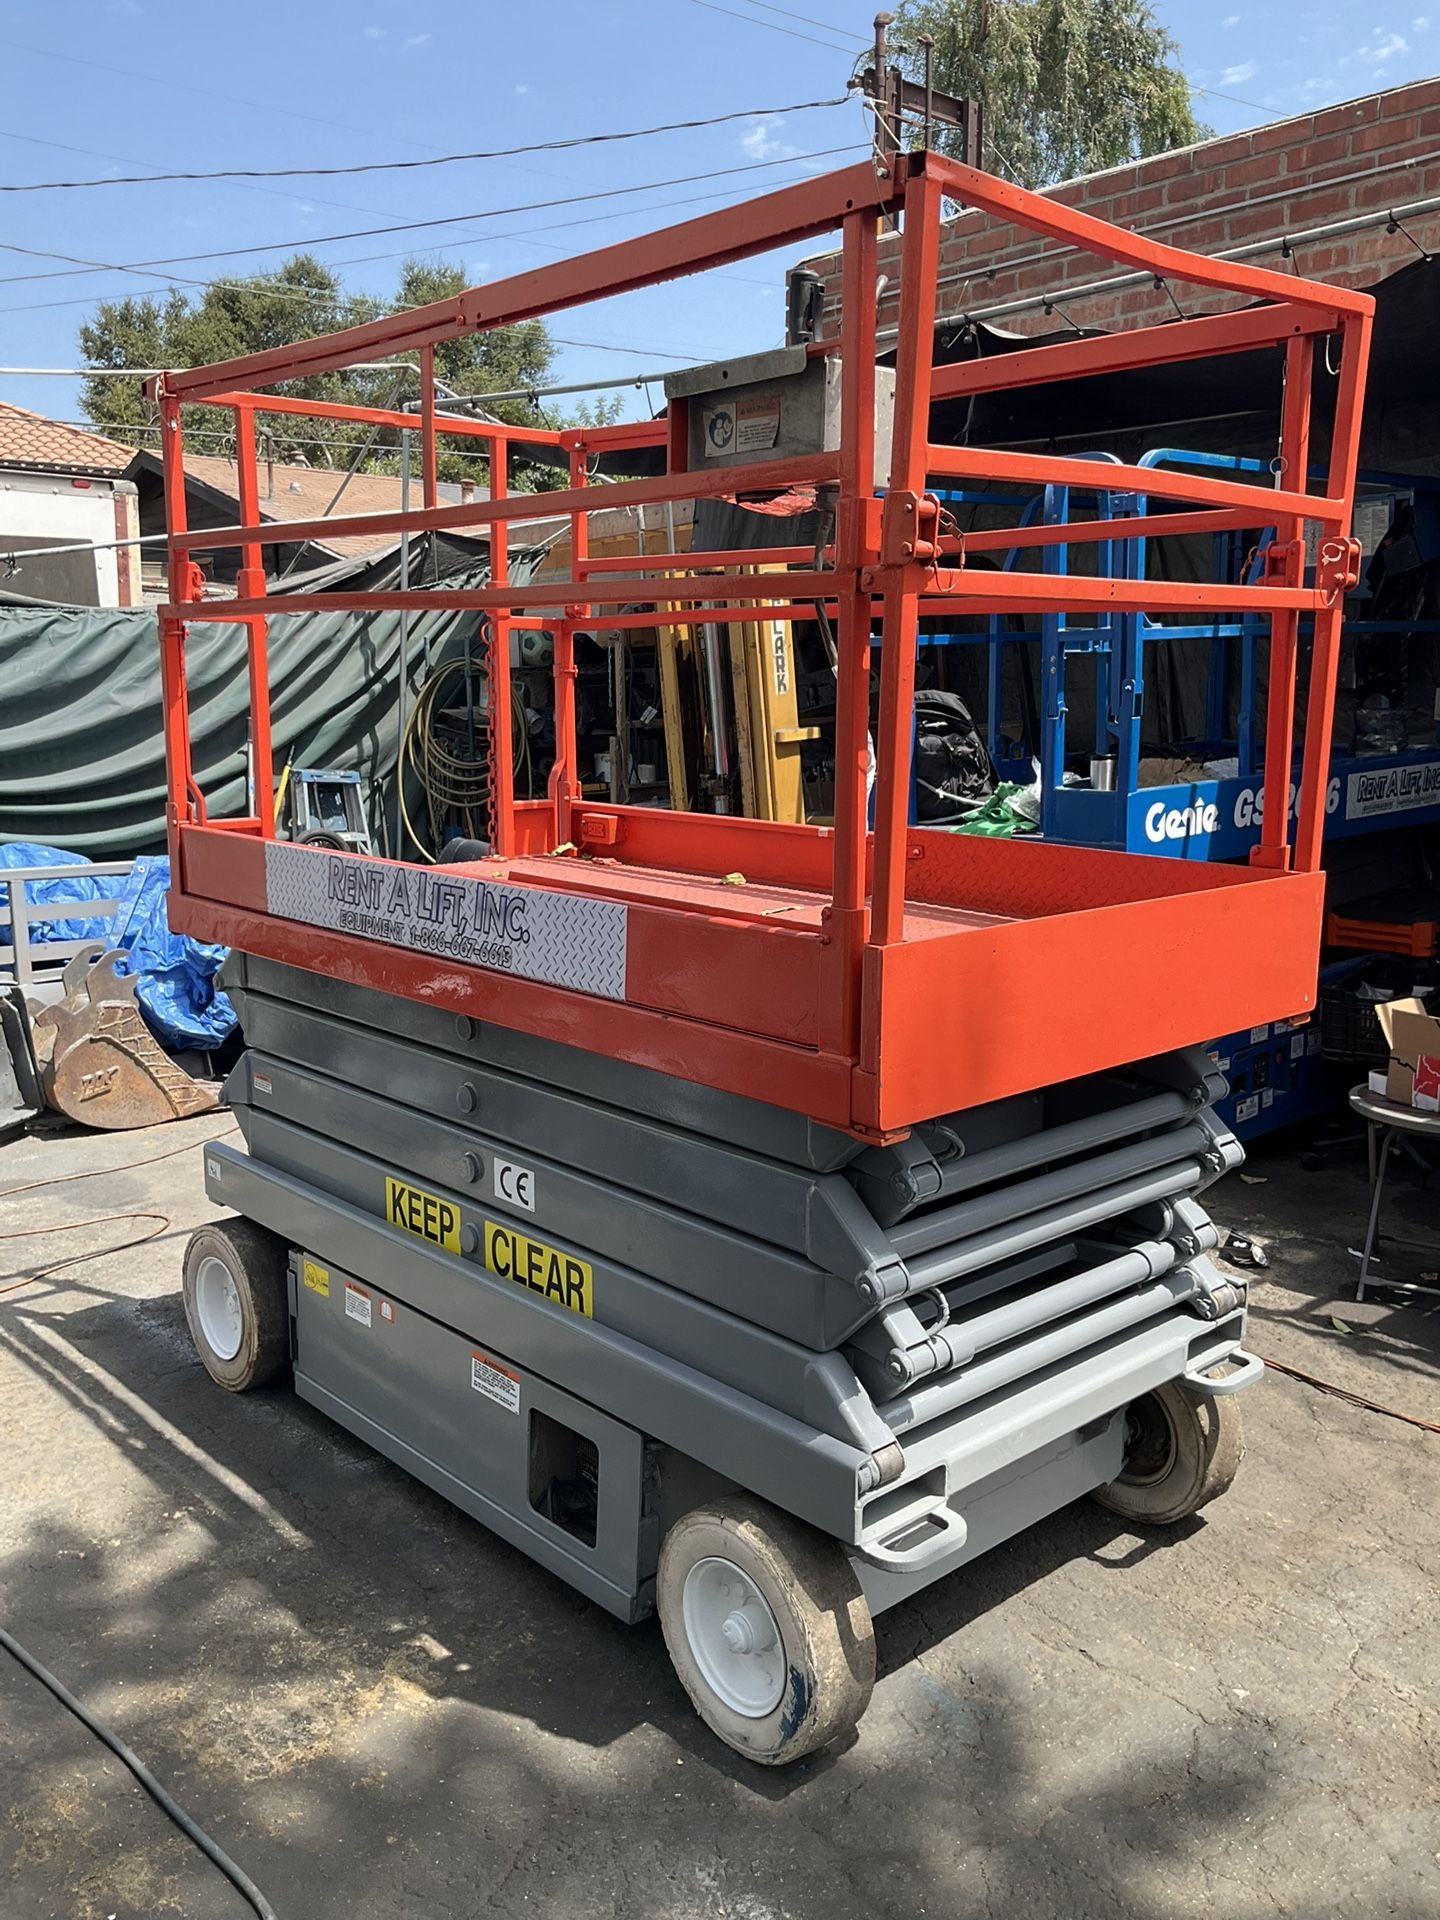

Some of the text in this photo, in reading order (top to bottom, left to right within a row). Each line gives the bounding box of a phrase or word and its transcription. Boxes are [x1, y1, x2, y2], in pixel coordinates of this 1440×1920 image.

[1357, 775, 1387, 802] RENT
[1386, 770, 1398, 798] A
[1145, 797, 1218, 843] Genie
[328, 856, 531, 944] RENT A LIFT, INC.
[340, 909, 405, 942] EQUIPMENT
[500, 1166, 529, 1206] CE
[391, 1183, 454, 1246] KEEP
[491, 1228, 585, 1314] CLEAR
